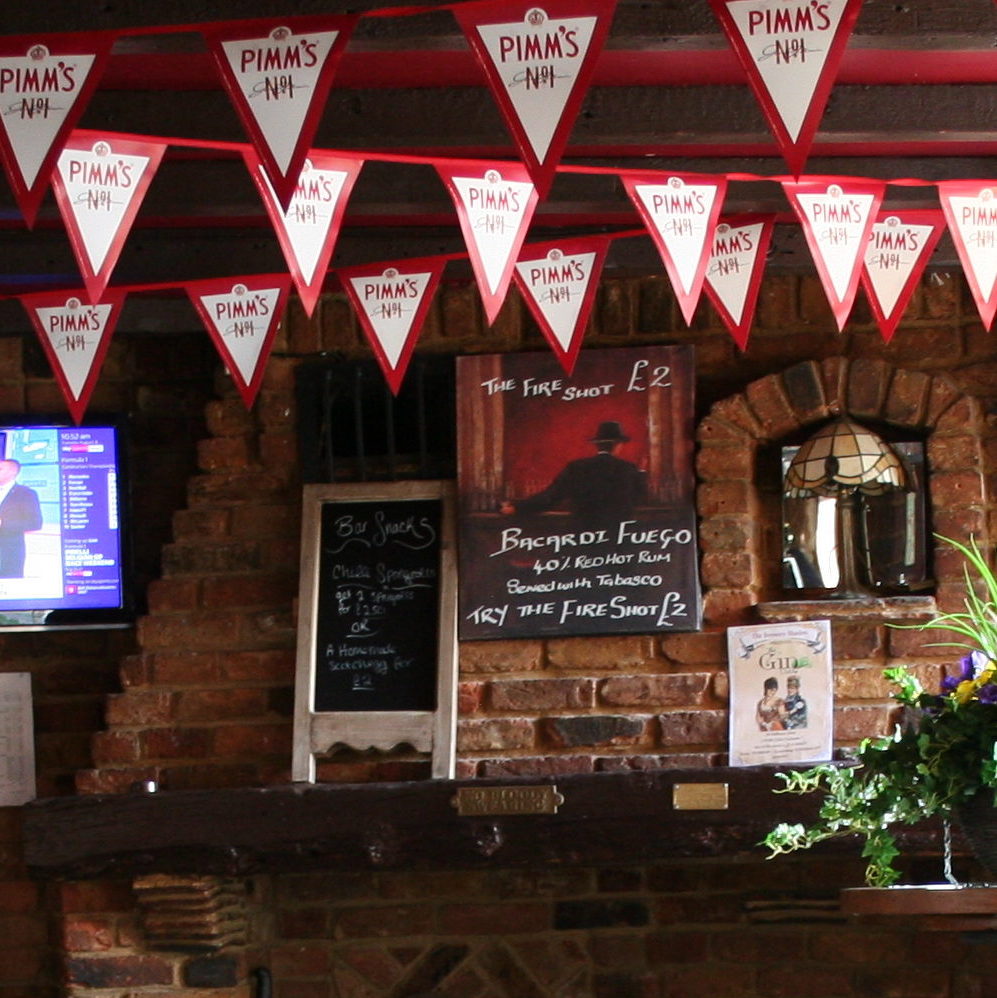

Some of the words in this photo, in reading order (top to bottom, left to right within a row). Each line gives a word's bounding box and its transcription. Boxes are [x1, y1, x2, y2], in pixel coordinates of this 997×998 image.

[748, 1, 831, 36] PIMM'S
[240, 40, 319, 74] PIMM'S
[500, 26, 580, 62] PIMM'S
[0, 61, 76, 94] PIMM'S
[69, 159, 132, 189] PIMM'S
[294, 175, 334, 203] MM'S
[469, 186, 520, 213] PIMM'S
[653, 191, 706, 215] PIMM'S
[813, 200, 862, 224] PIMM'S
[962, 206, 997, 227] PIMM
[711, 232, 753, 257] IMM'S
[868, 230, 918, 251] PIMM'S
[530, 260, 586, 287] PIMM'S
[364, 279, 419, 301] PIMM'S
[49, 309, 101, 333] PIMM'S
[216, 296, 270, 320] PIMM'S
[481, 377, 516, 396] THE
[523, 378, 563, 398] FIRE
[562, 384, 615, 401] SHOT
[335, 515, 368, 537] Bar
[373, 511, 436, 550] Snacks
[489, 527, 609, 558] BACARDI
[617, 520, 692, 550] FUEGO
[638, 550, 671, 564] RUM
[596, 574, 663, 588] Tabasco
[466, 604, 510, 628] TRY
[517, 602, 555, 617] THE
[559, 599, 608, 624] FIRE
[609, 595, 659, 620] SHOT
